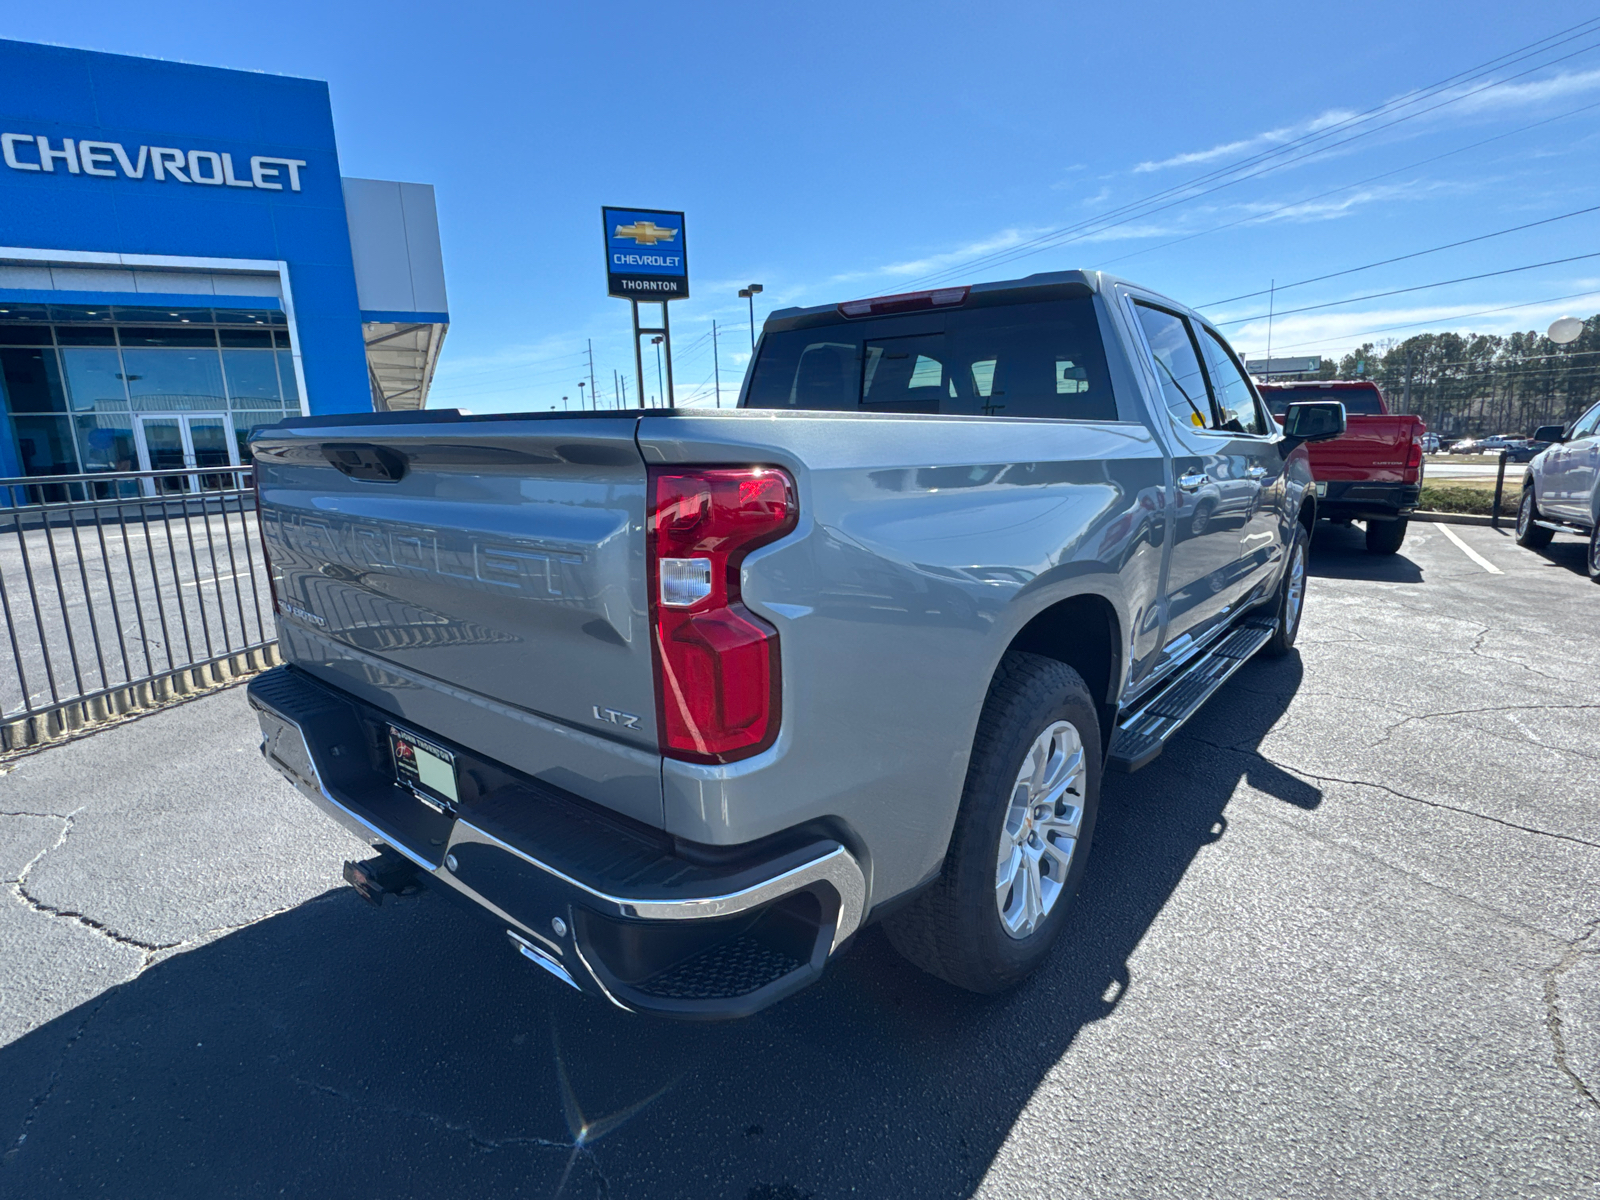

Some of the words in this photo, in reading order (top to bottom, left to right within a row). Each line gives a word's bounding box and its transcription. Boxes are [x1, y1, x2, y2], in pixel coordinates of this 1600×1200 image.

[1, 132, 307, 191] CHEVROLET
[613, 254, 680, 267] CHEVROLET
[621, 279, 678, 291] THORNTON
[592, 704, 642, 731] LTZ
